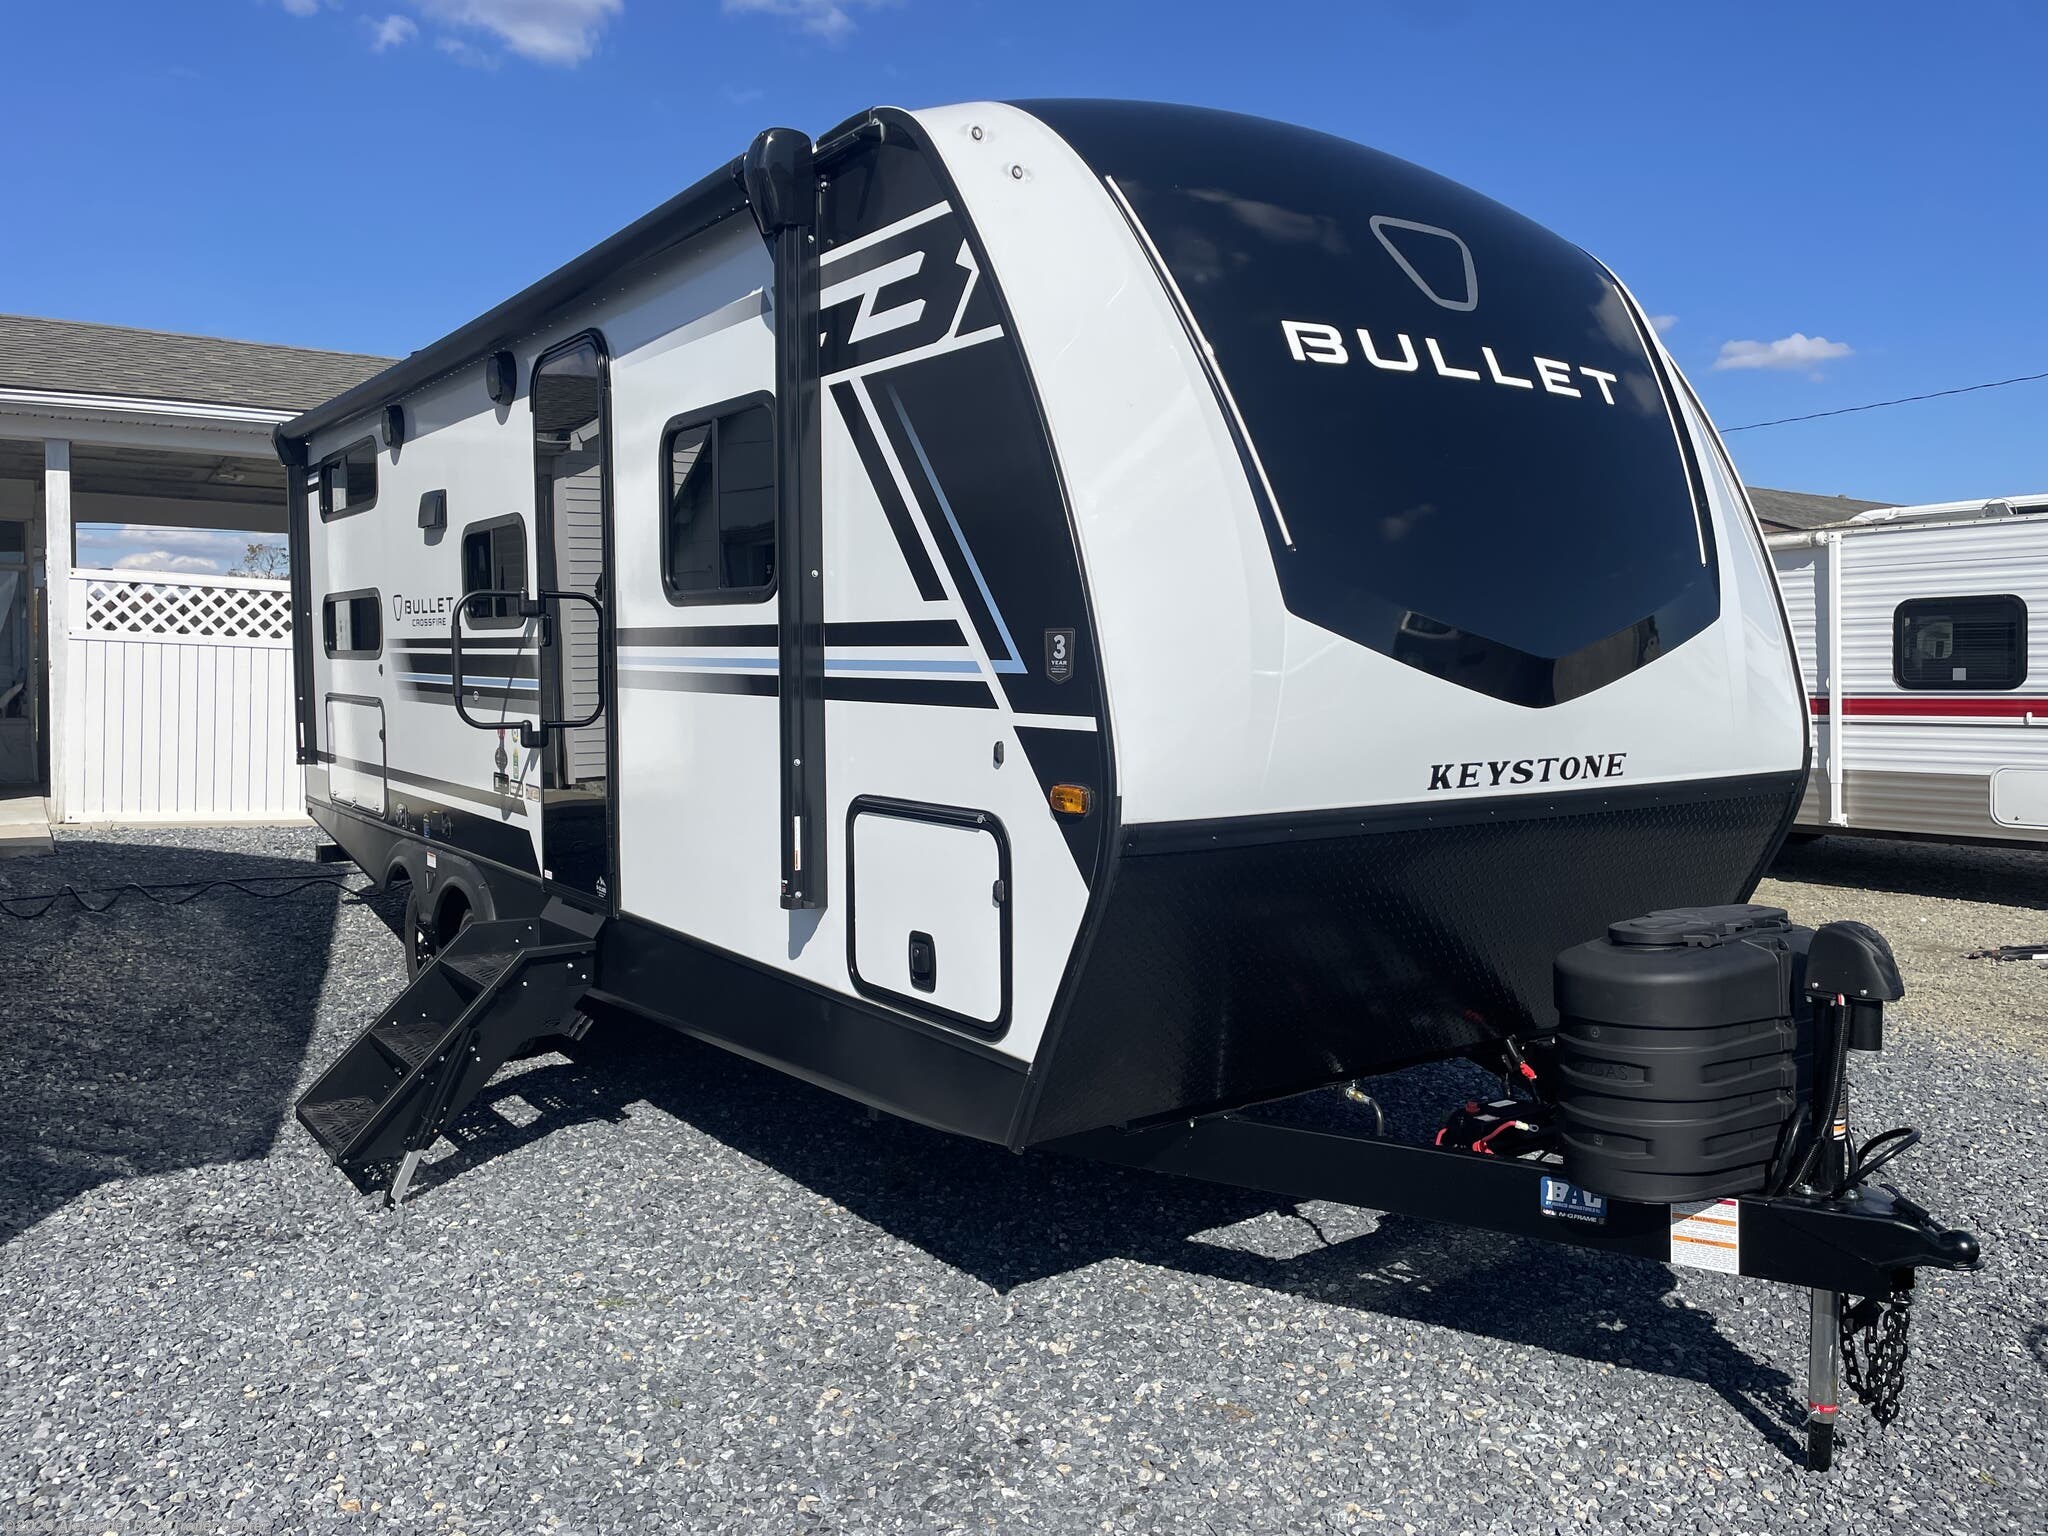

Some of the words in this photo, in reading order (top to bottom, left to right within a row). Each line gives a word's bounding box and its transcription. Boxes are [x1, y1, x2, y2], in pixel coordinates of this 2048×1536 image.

[1281, 319, 1618, 406] BULLET
[405, 596, 454, 615] BULLET
[412, 617, 447, 627] CROSSFIRE
[1053, 634, 1066, 660] 3
[1427, 752, 1627, 791] KEYSTONE
